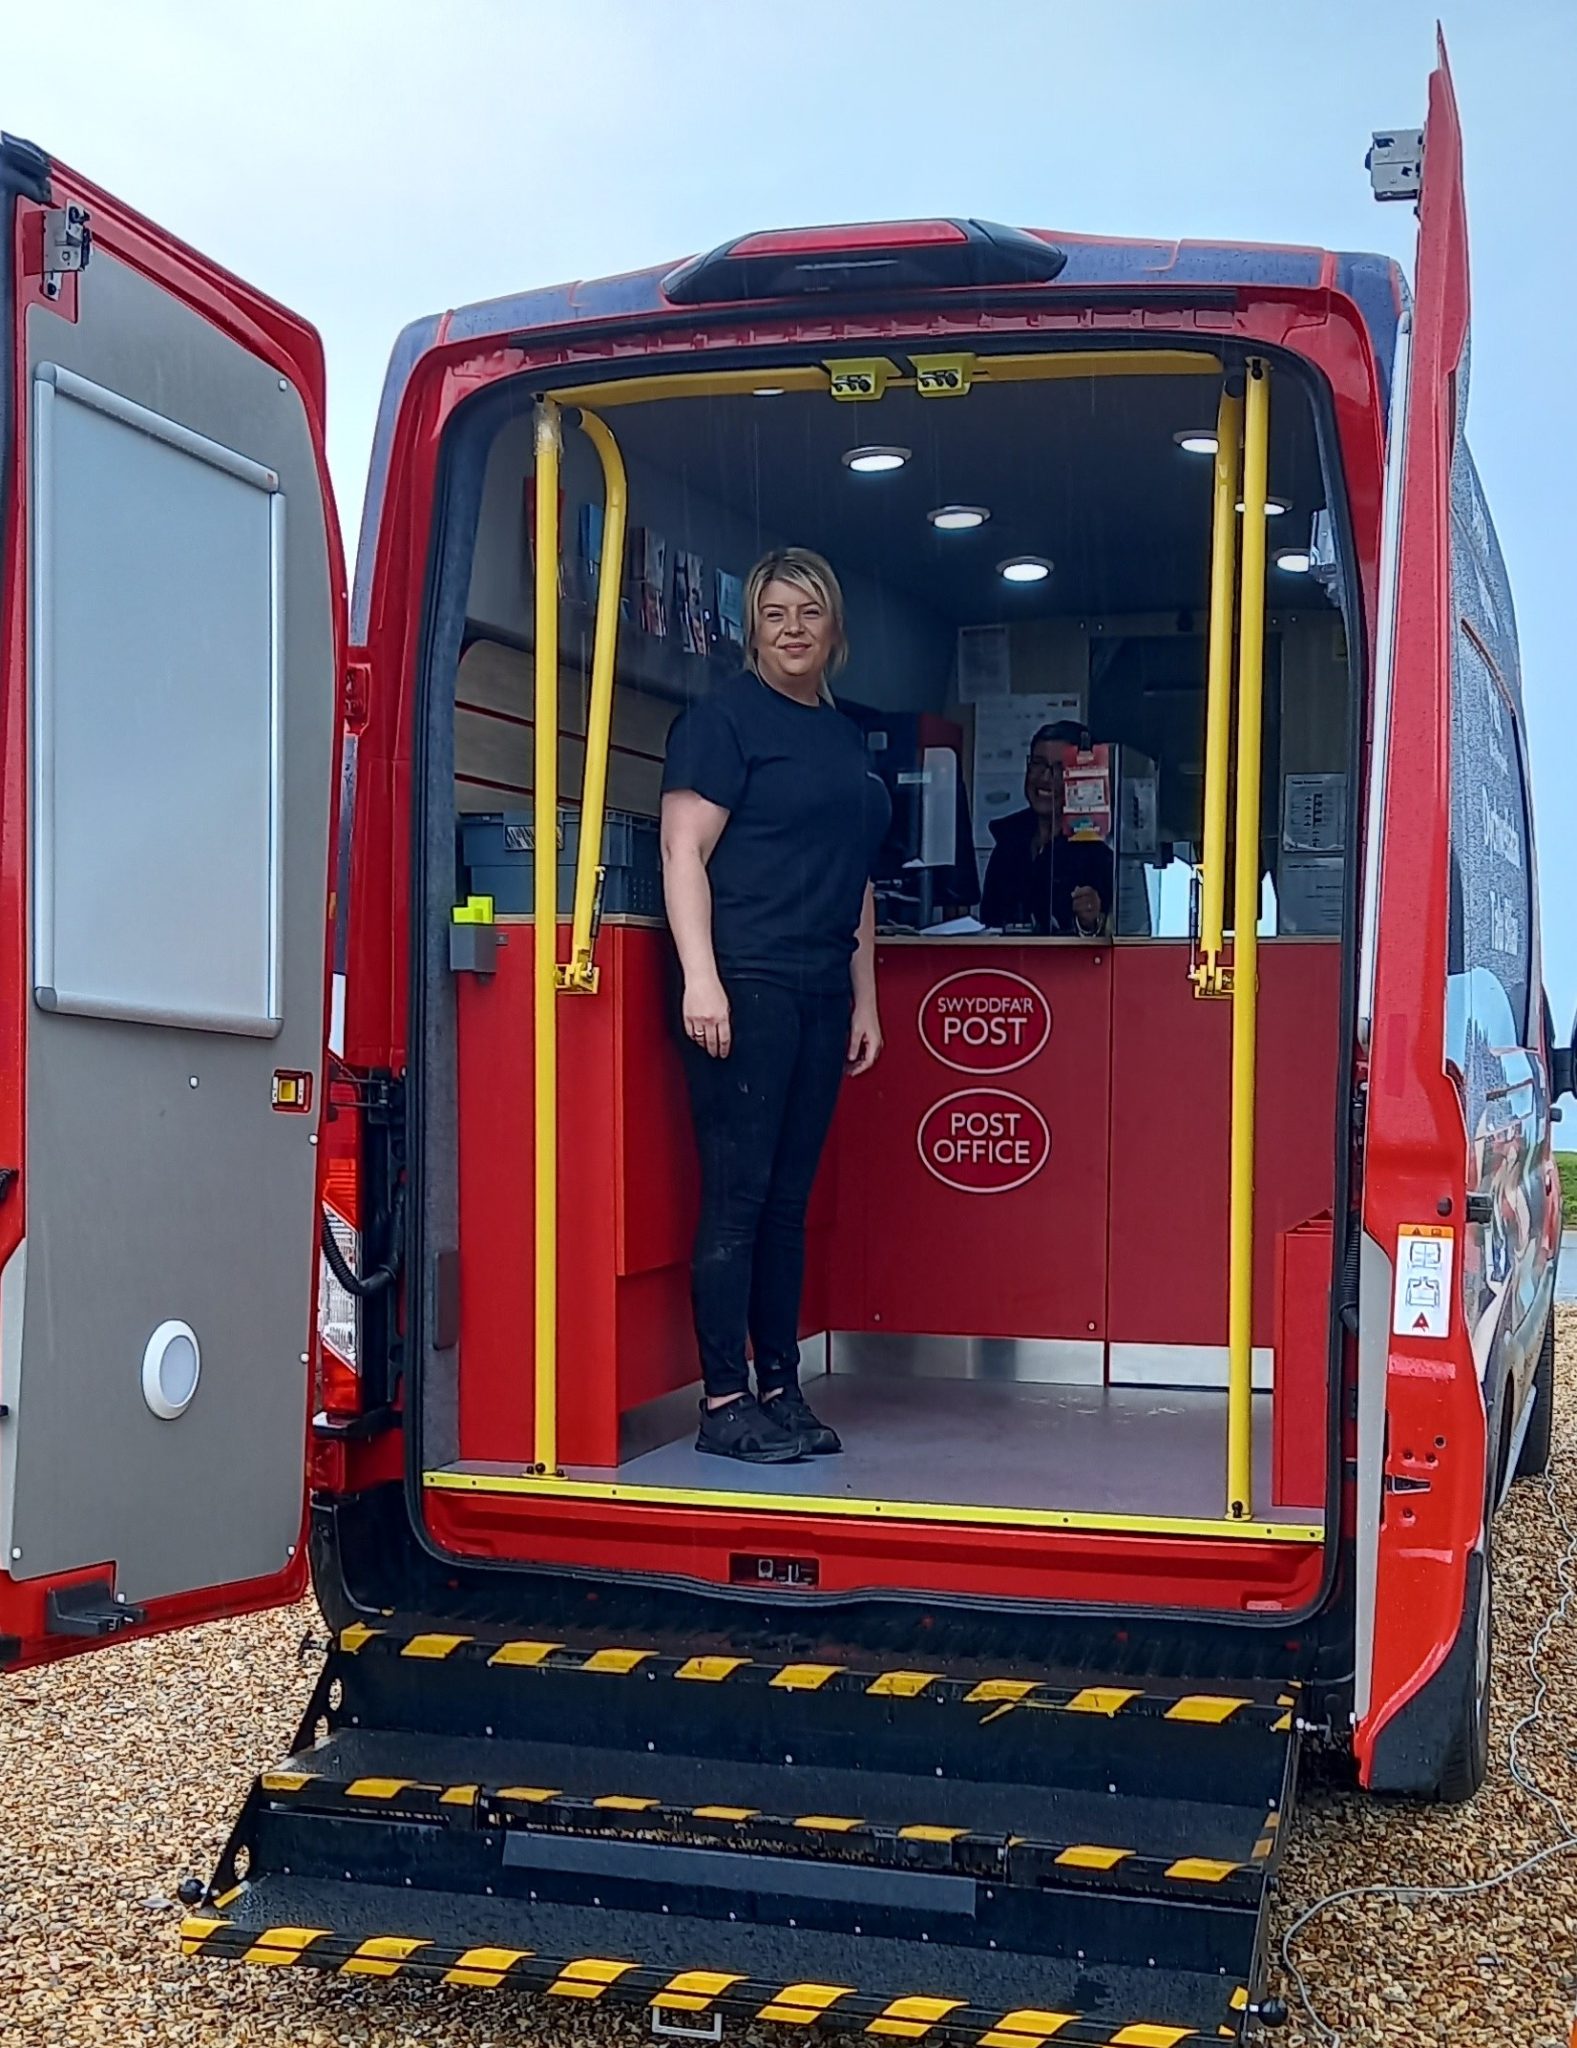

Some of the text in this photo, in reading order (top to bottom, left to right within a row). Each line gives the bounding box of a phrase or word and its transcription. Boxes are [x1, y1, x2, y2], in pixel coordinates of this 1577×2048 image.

[944, 1017, 1028, 1045] POST
[951, 1112, 1021, 1137] POST
[933, 1139, 1031, 1164] OFFICE
